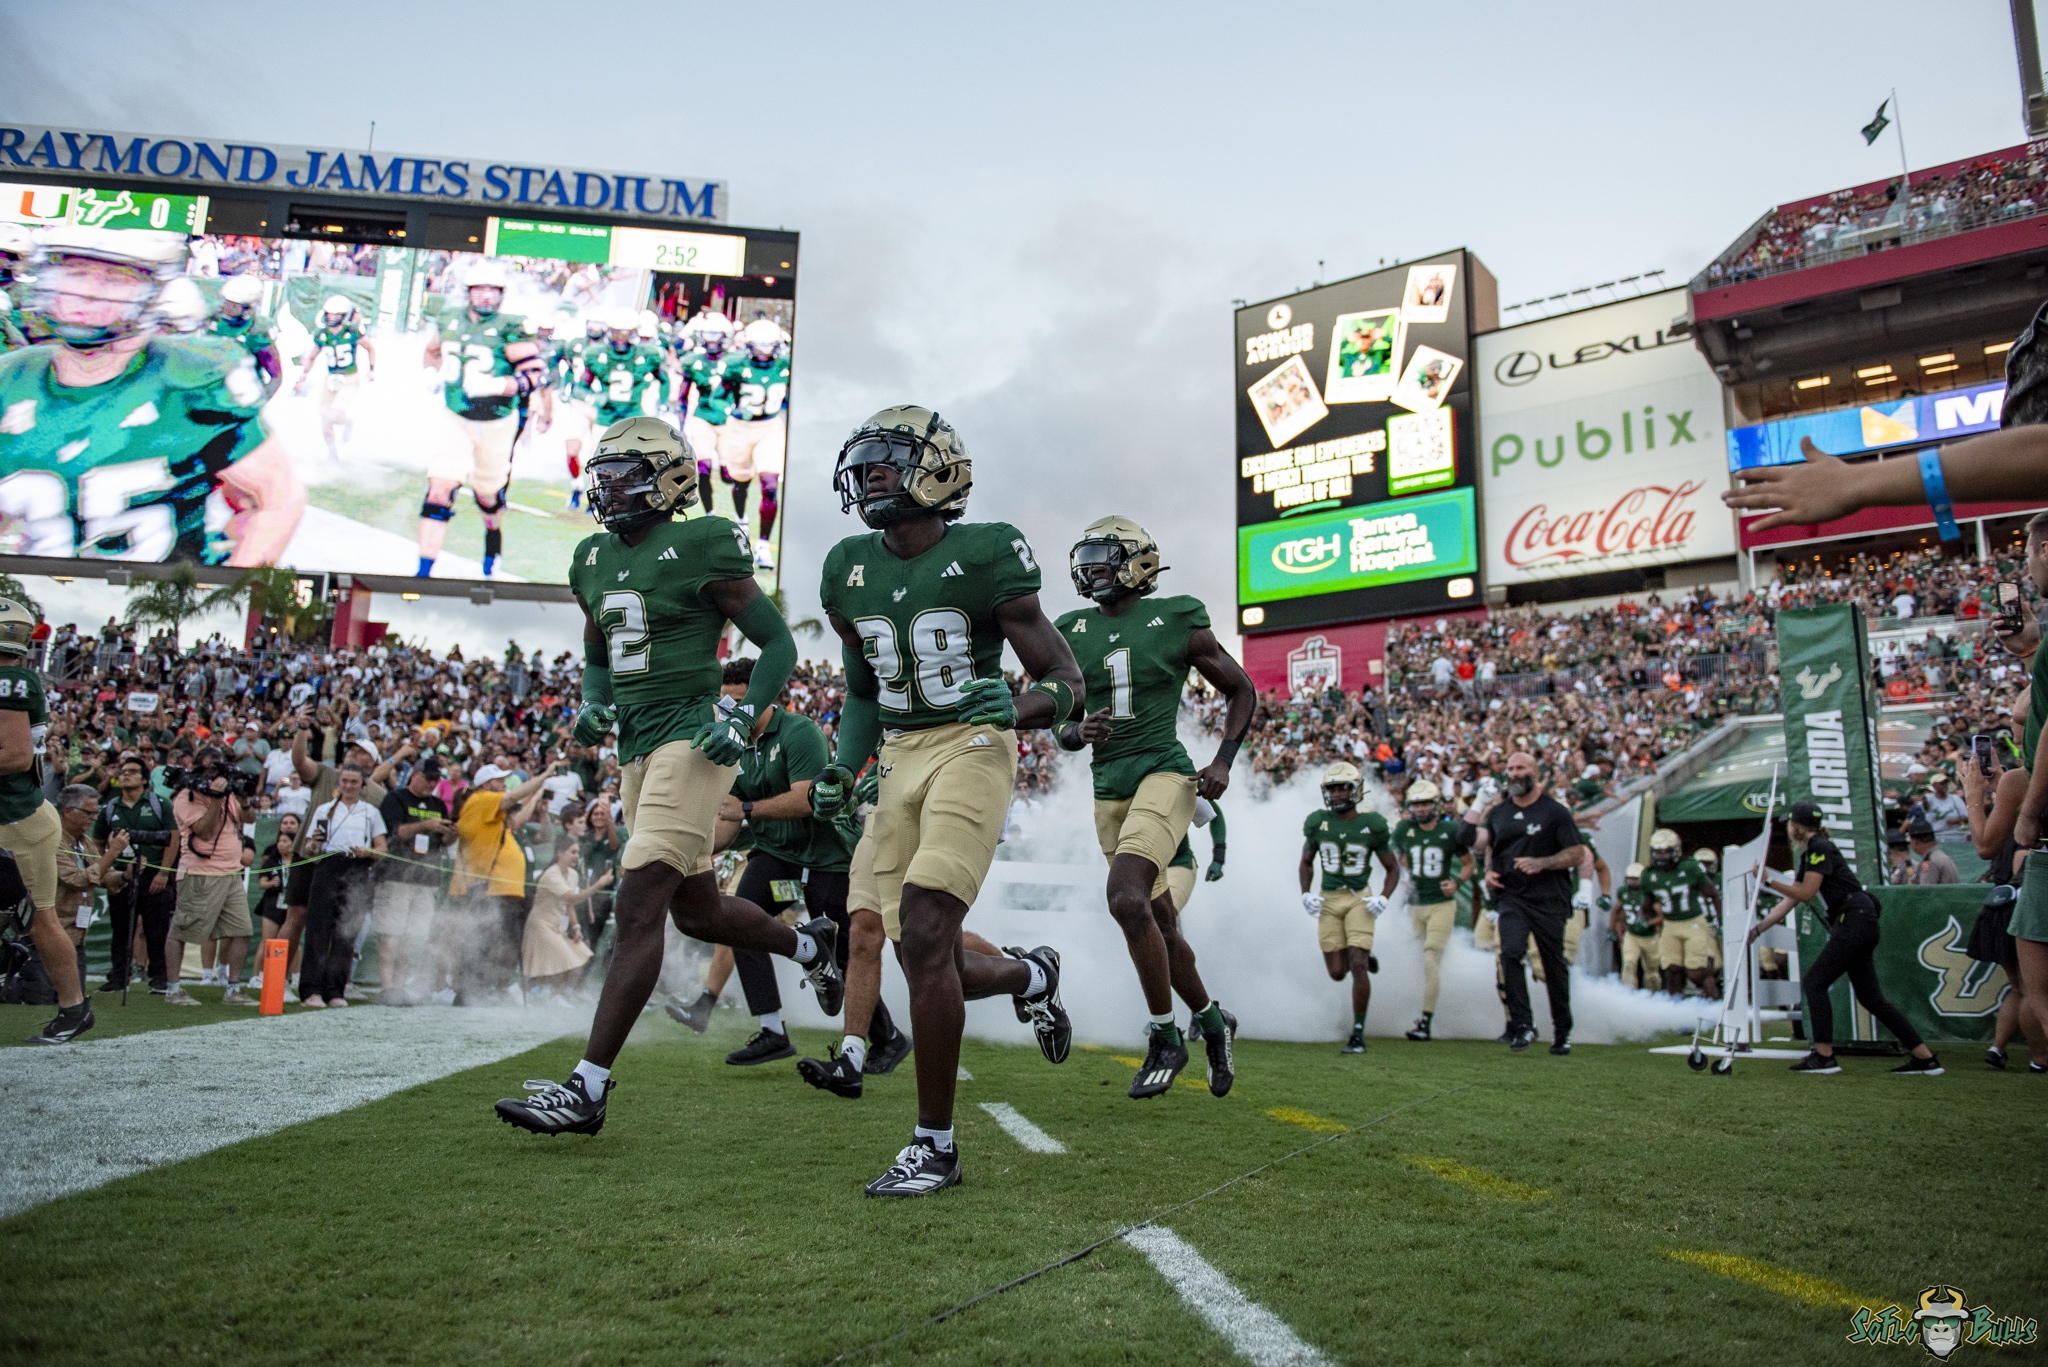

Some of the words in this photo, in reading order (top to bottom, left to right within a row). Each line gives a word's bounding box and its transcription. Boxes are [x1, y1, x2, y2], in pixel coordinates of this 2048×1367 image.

[0, 128, 278, 183] RAYMOND
[287, 151, 469, 198] JAMES
[482, 164, 720, 219] STADIUM
[655, 244, 698, 268] 2:52
[1246, 323, 1314, 353] FOWLER
[1246, 336, 1314, 365] AVENUE
[608, 371, 634, 402] 2
[1348, 513, 1418, 537] Tampa
[1350, 525, 1428, 554] General
[1279, 532, 1341, 566] TGH
[600, 589, 651, 676] 2
[853, 606, 978, 713] 28
[1103, 647, 1136, 720] 1
[1804, 709, 1855, 831] FLORIDA
[1409, 845, 1444, 878] 18
